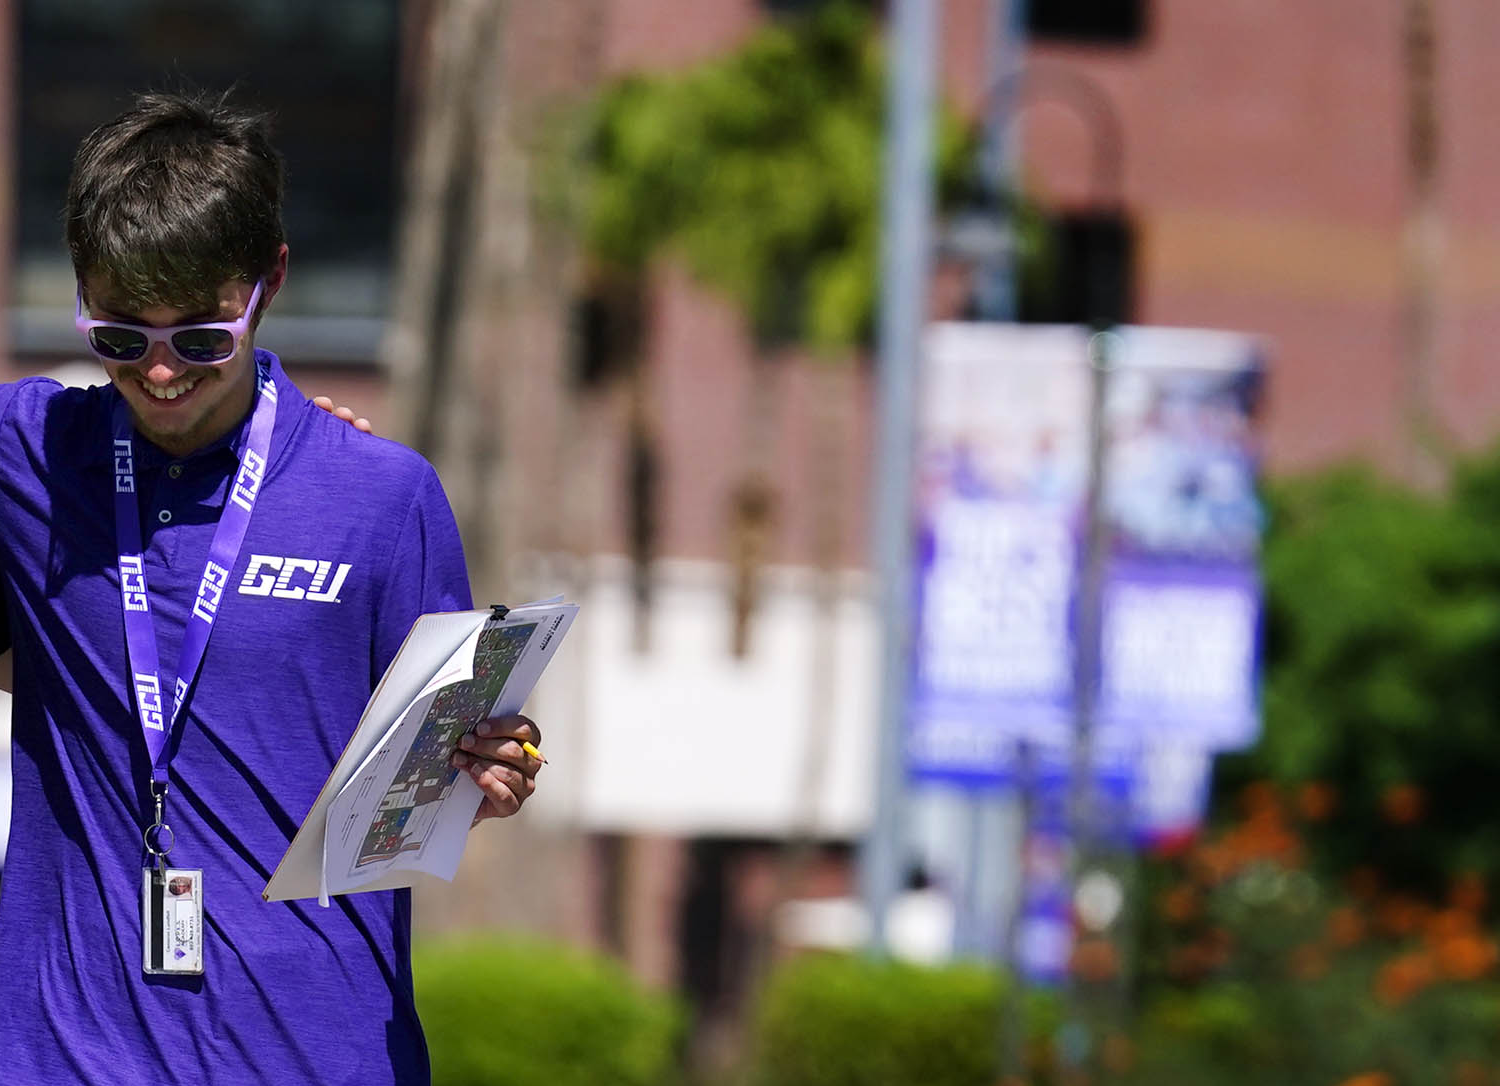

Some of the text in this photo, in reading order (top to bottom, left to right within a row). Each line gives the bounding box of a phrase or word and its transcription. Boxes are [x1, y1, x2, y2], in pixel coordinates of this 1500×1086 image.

[114, 439, 135, 493] GCU
[230, 447, 266, 513] GCU
[119, 555, 149, 612] GCU
[192, 560, 229, 625] GCU
[238, 554, 353, 603] GCU
[135, 672, 165, 732] GCU
